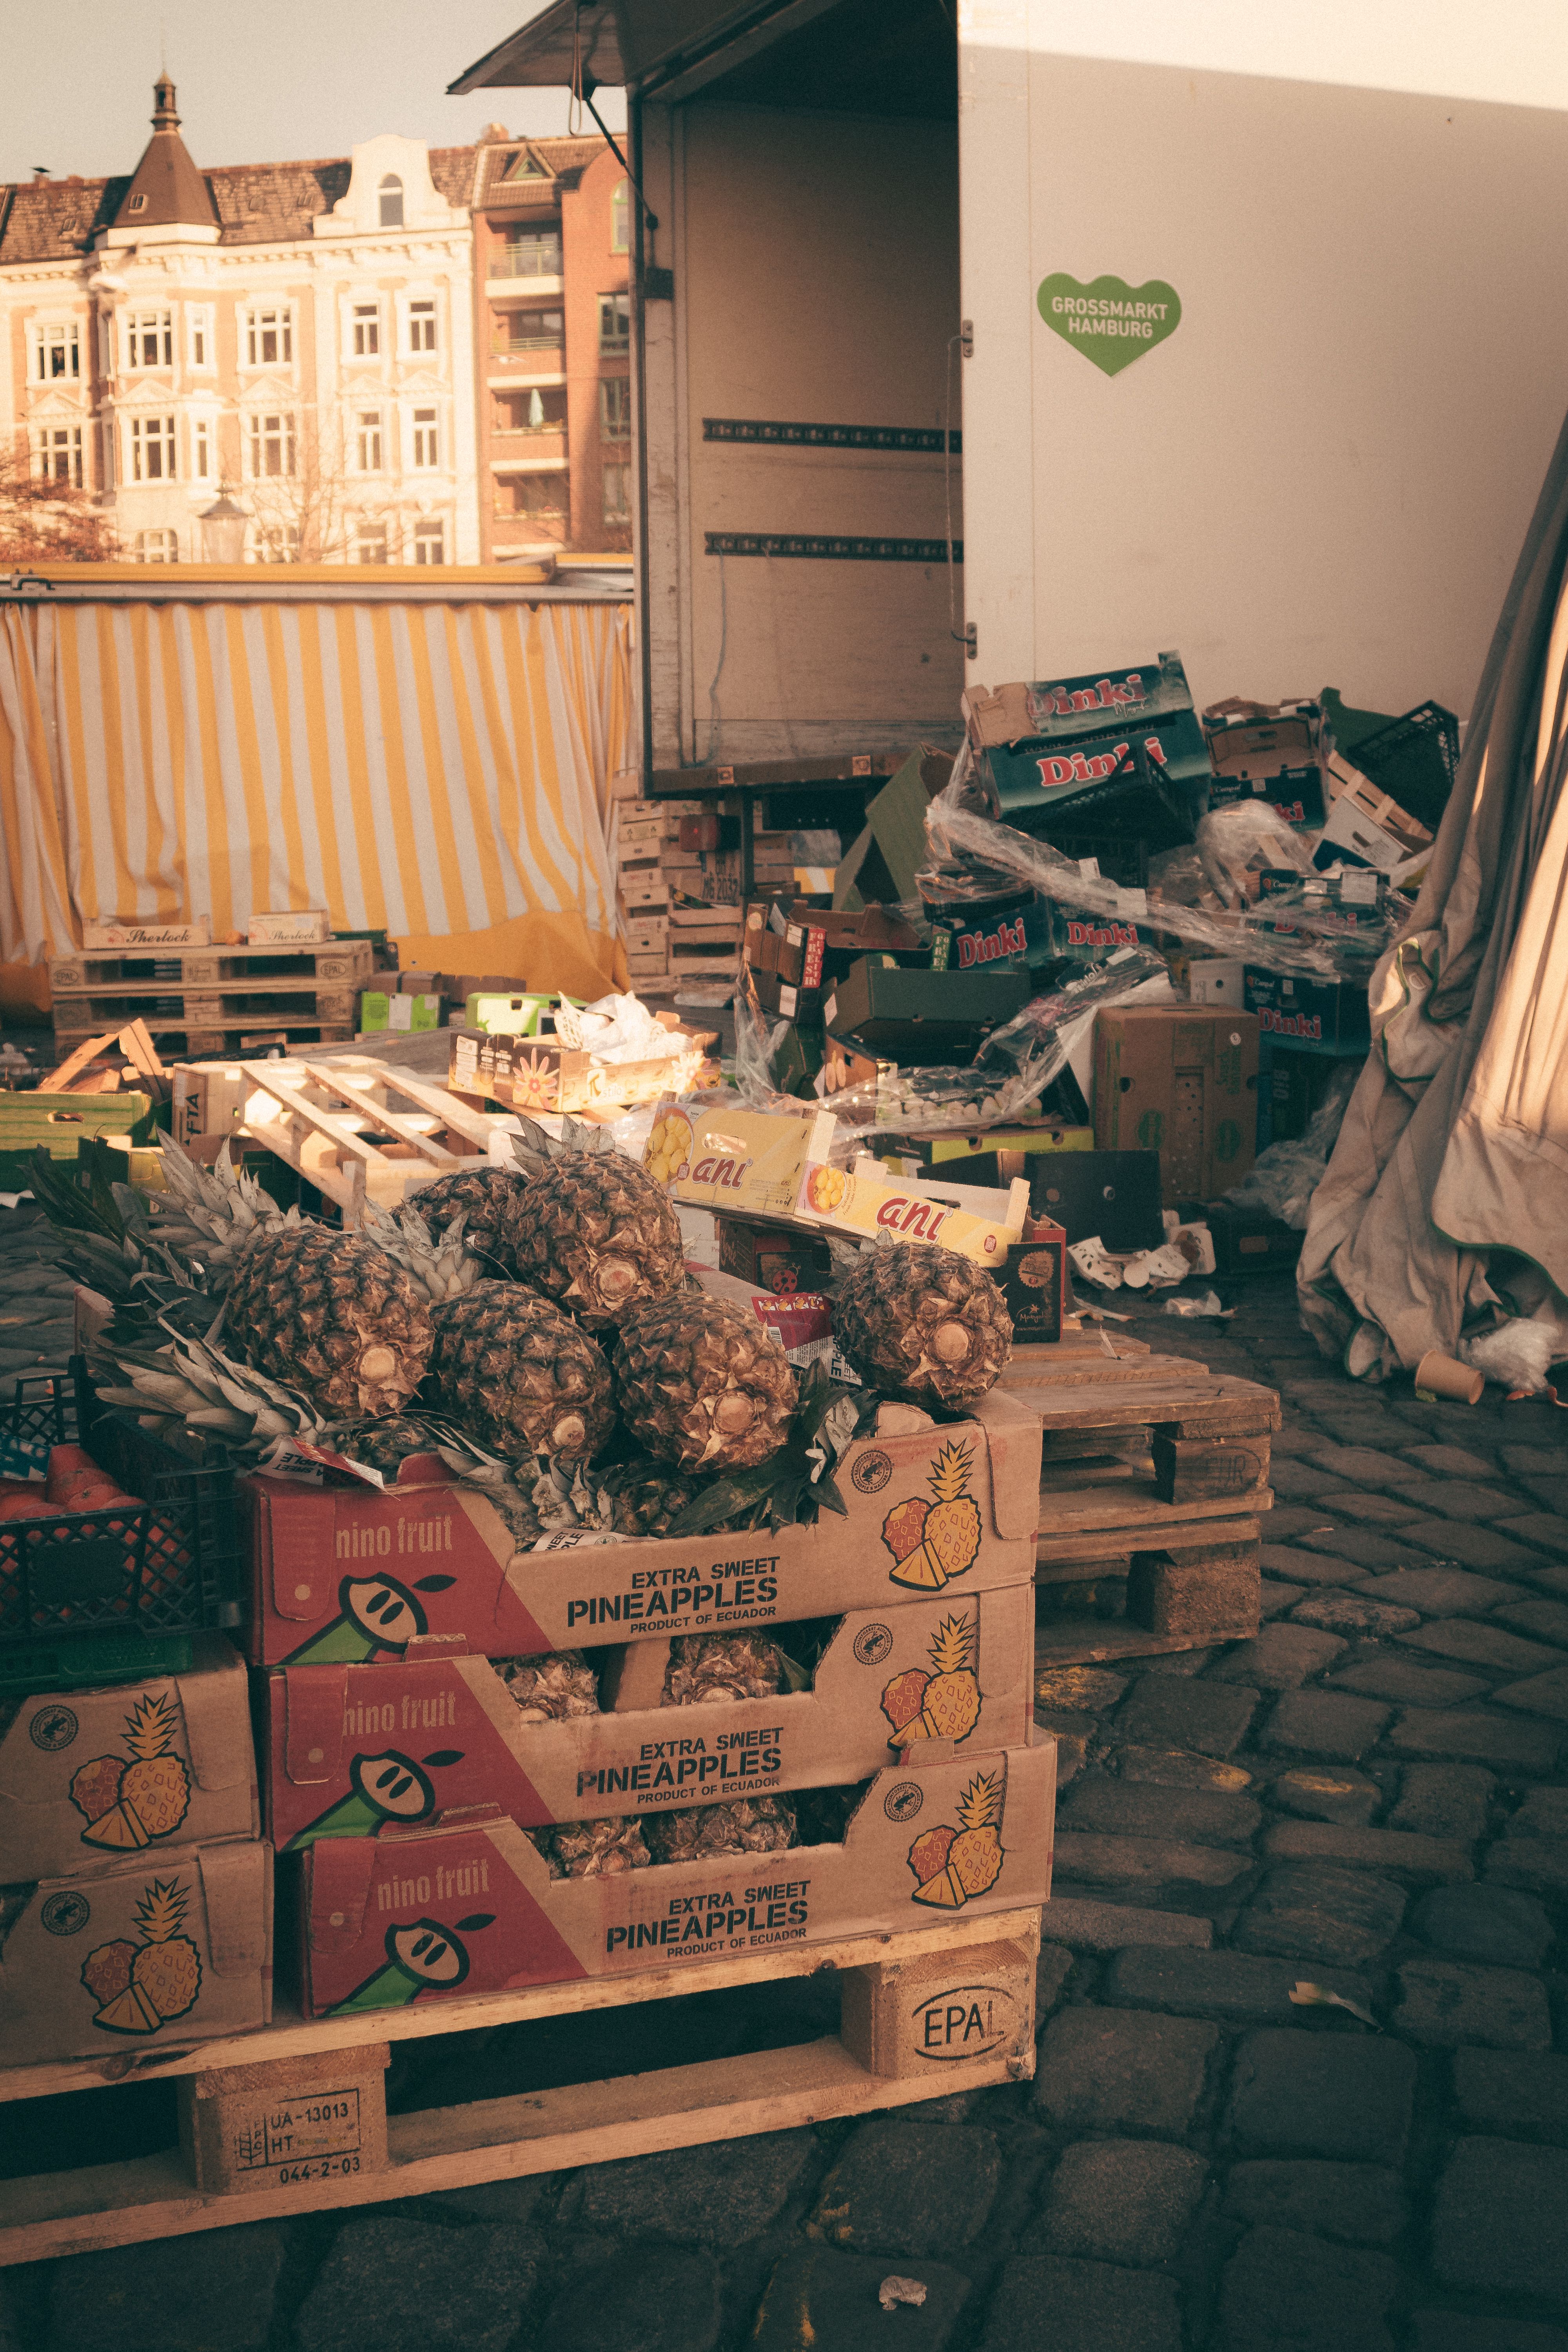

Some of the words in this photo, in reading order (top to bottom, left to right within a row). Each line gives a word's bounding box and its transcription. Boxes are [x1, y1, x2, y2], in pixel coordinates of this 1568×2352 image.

[1052, 296, 1169, 320] GROSSMARKT
[1068, 318, 1153, 338] HAMBURG
[1028, 674, 1146, 717] Dinki
[126, 929, 191, 943] Sherlock
[269, 930, 316, 940] Sherlock
[957, 917, 1027, 968] Dinki
[1067, 922, 1139, 945] Dinki
[324, 965, 341, 974] EPAL
[1258, 1007, 1322, 1039] Dinki
[336, 1522, 391, 1558] nino
[398, 1514, 453, 1553] fruit
[632, 1566, 701, 1589] EXTRA
[710, 1556, 780, 1579] SWEET
[567, 1577, 778, 1627] PINEAPPLES
[630, 1616, 690, 1633] PRODUCT
[695, 1614, 713, 1626] OF
[716, 1606, 776, 1622] ECUADOR
[343, 1701, 395, 1736] nino
[402, 1690, 456, 1729] fruit
[640, 1737, 706, 1761] EXTRA
[715, 1727, 784, 1750] SWEET
[577, 1748, 781, 1797] PINEAPPLES
[637, 1788, 695, 1804] PRODUCT
[701, 1785, 717, 1796] OF
[722, 1777, 780, 1794] ECUADOR
[378, 1875, 430, 1911] nino
[436, 1858, 489, 1900] fruit
[669, 1891, 735, 1915] EXTRA
[744, 1880, 811, 1903] SWEET
[606, 1900, 808, 1953] PINEAPPLES
[667, 1940, 725, 1958] PRODUCT
[730, 1938, 746, 1949] OF
[750, 1928, 807, 1946] ECUADOR
[925, 2001, 1004, 2047] EPAL
[271, 2102, 348, 2129] UA-13013
[272, 2135, 293, 2154] HT
[280, 2156, 360, 2184] 044-2-03
